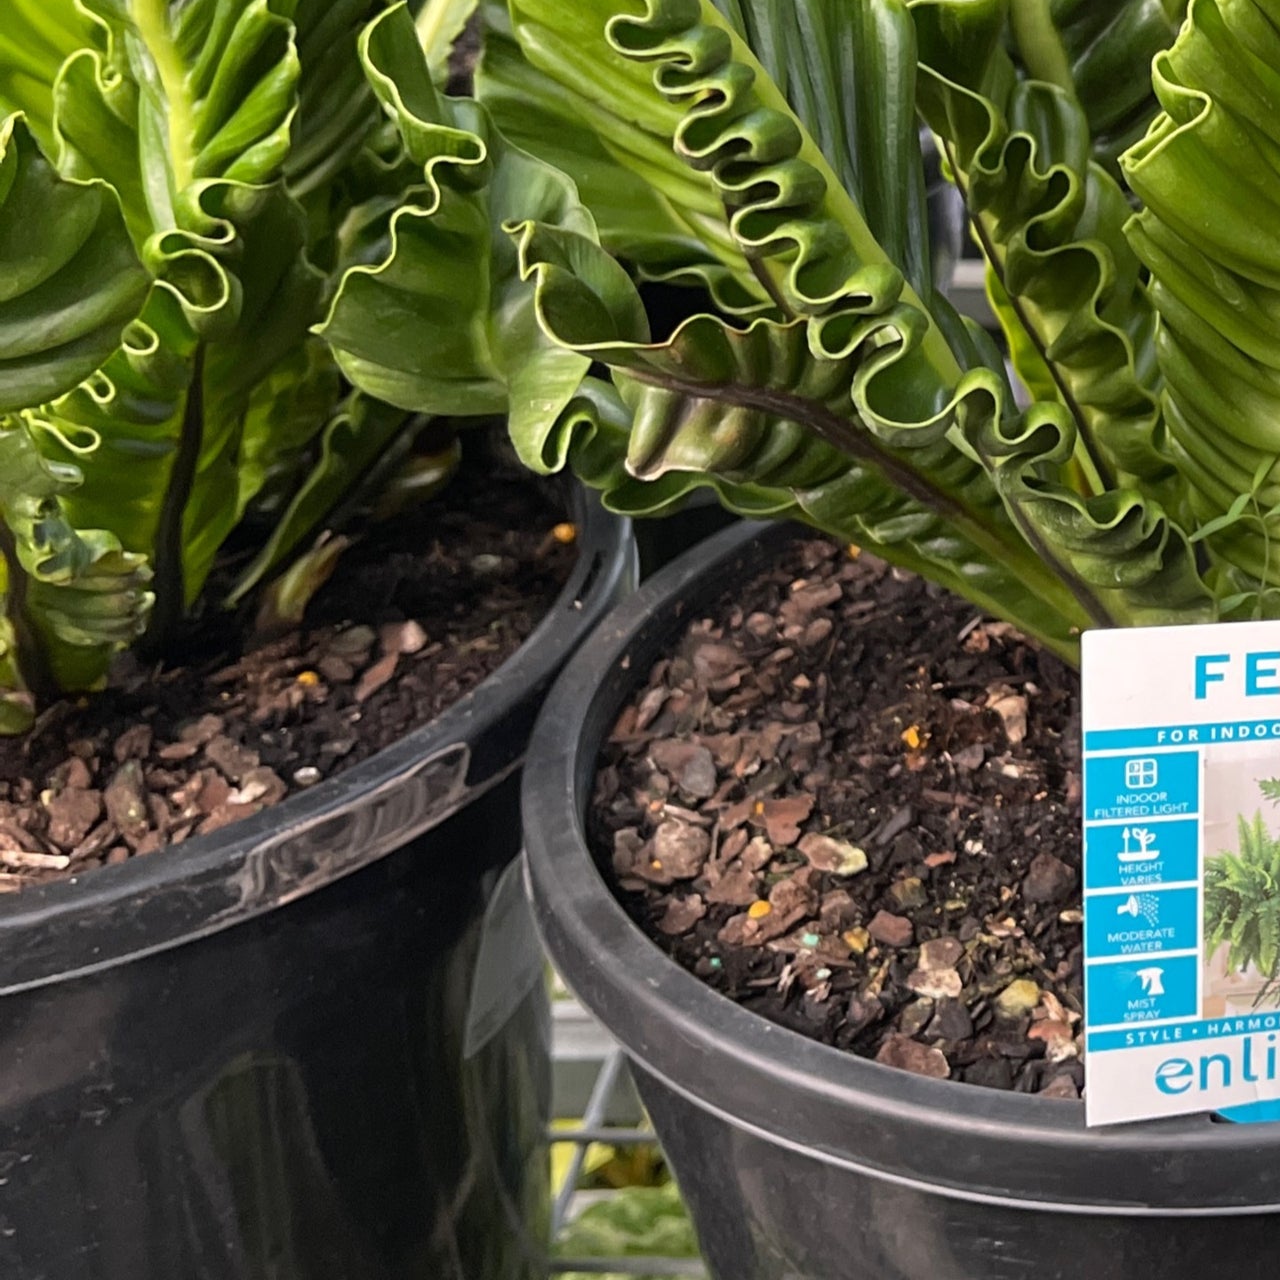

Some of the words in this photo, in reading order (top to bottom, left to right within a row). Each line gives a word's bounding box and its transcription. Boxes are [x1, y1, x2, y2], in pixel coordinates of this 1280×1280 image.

[1157, 729, 1199, 743] FOR
[1116, 792, 1168, 805] INDOOR
[1094, 805, 1149, 818] FILTERED
[1153, 802, 1189, 815] LIGHT
[1118, 861, 1165, 874] HEIGHT
[1120, 873, 1162, 886] VARIES
[1107, 927, 1175, 942] MODERATE
[1120, 941, 1163, 954] WATER
[1127, 998, 1156, 1010] MIST
[1123, 1009, 1161, 1022] SPRAY
[1125, 1028, 1183, 1045] STYLE
